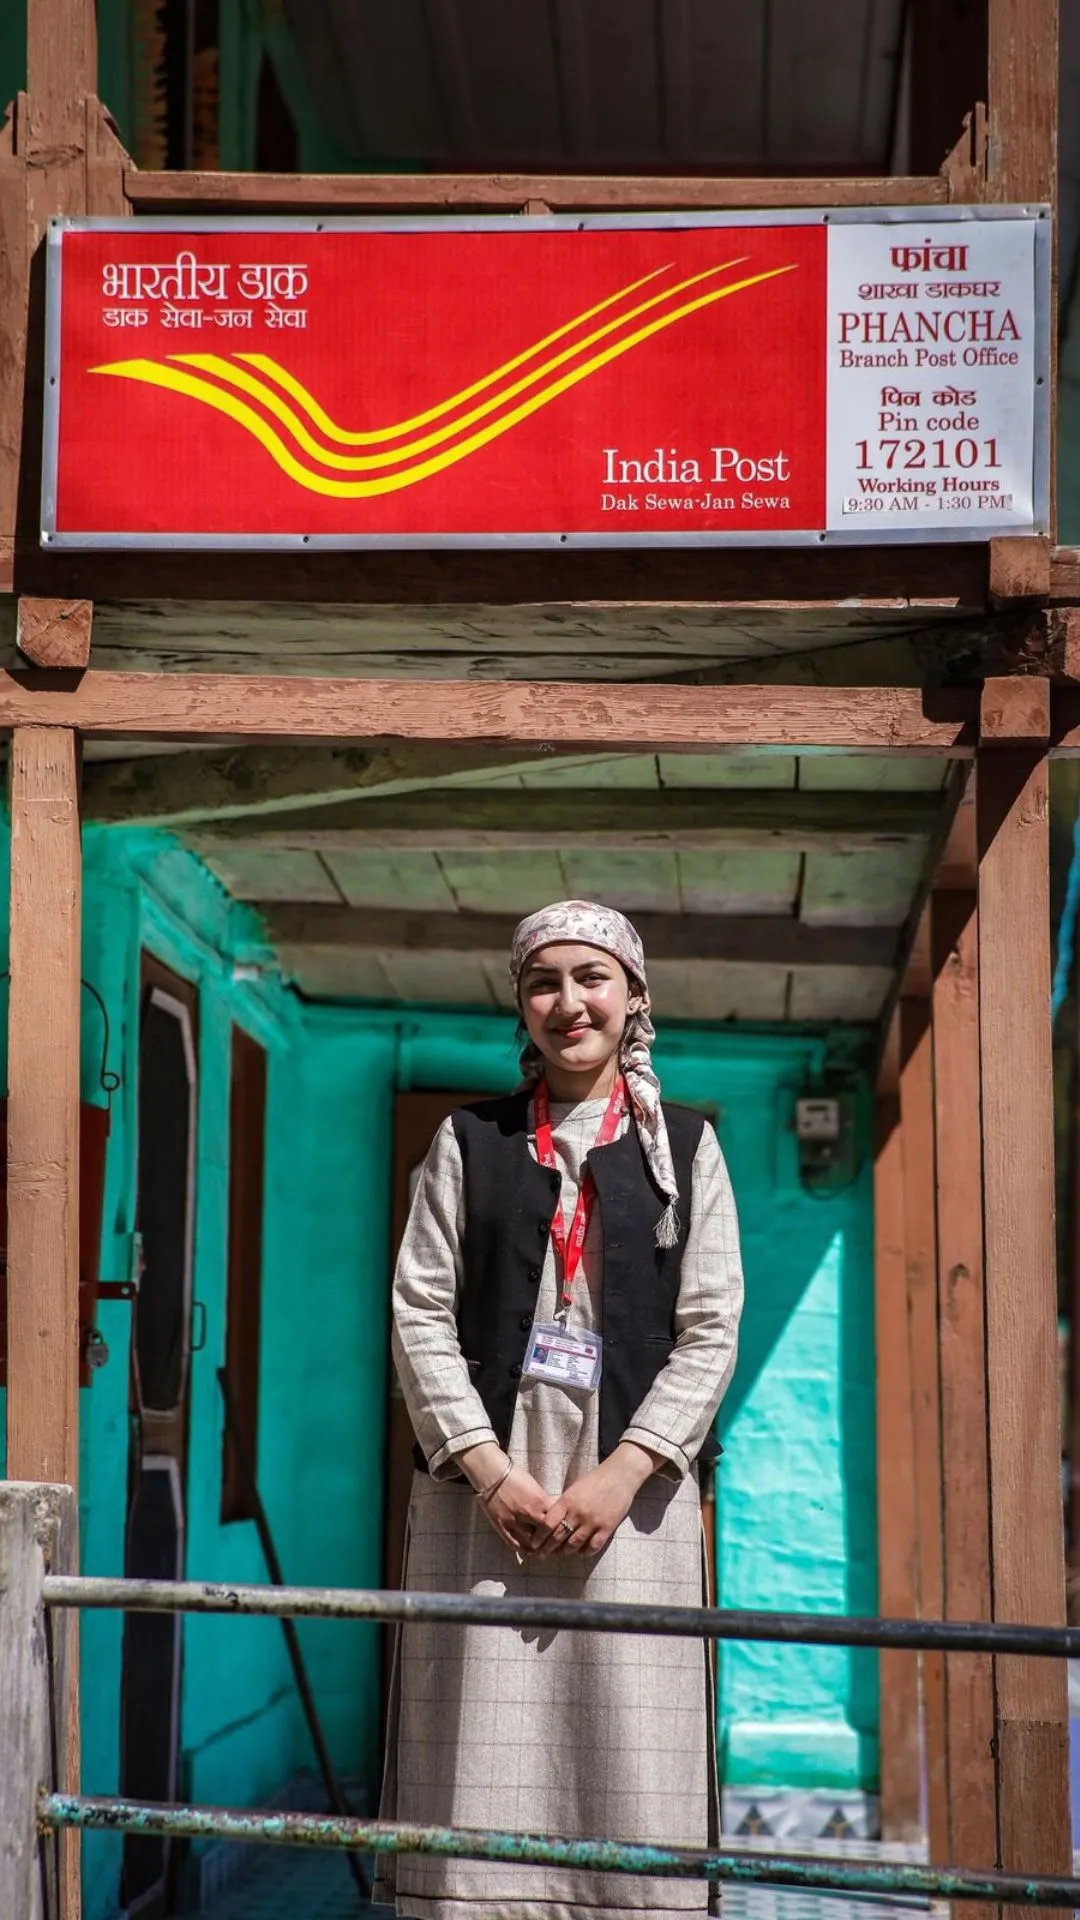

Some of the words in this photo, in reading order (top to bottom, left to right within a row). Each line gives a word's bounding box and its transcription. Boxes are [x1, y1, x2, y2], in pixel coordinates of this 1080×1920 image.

[102, 251, 231, 300] भारतीय
[237, 264, 308, 300] डाक
[858, 282, 919, 300] शाखा
[925, 281, 1002, 298] डाकघर
[102, 308, 149, 328] डाक
[264, 301, 307, 328] सेवा
[838, 309, 1022, 344] PHANCHA
[839, 348, 908, 368] Branch
[915, 348, 956, 367] Post
[963, 346, 1019, 366] Office
[880, 386, 921, 407] पिन
[932, 385, 977, 407] कोड
[877, 412, 919, 432] Pin
[926, 411, 980, 431] code
[855, 437, 1003, 470] 172101
[602, 448, 702, 484] India
[710, 447, 791, 482] Post
[858, 477, 937, 496] Working
[942, 476, 1000, 492] Hours
[601, 493, 639, 511] Dak
[741, 492, 790, 509] Sewa
[848, 497, 884, 511] 9:30
[888, 496, 918, 511] AM
[938, 495, 972, 510] 1:30
[978, 494, 1006, 509] PM
